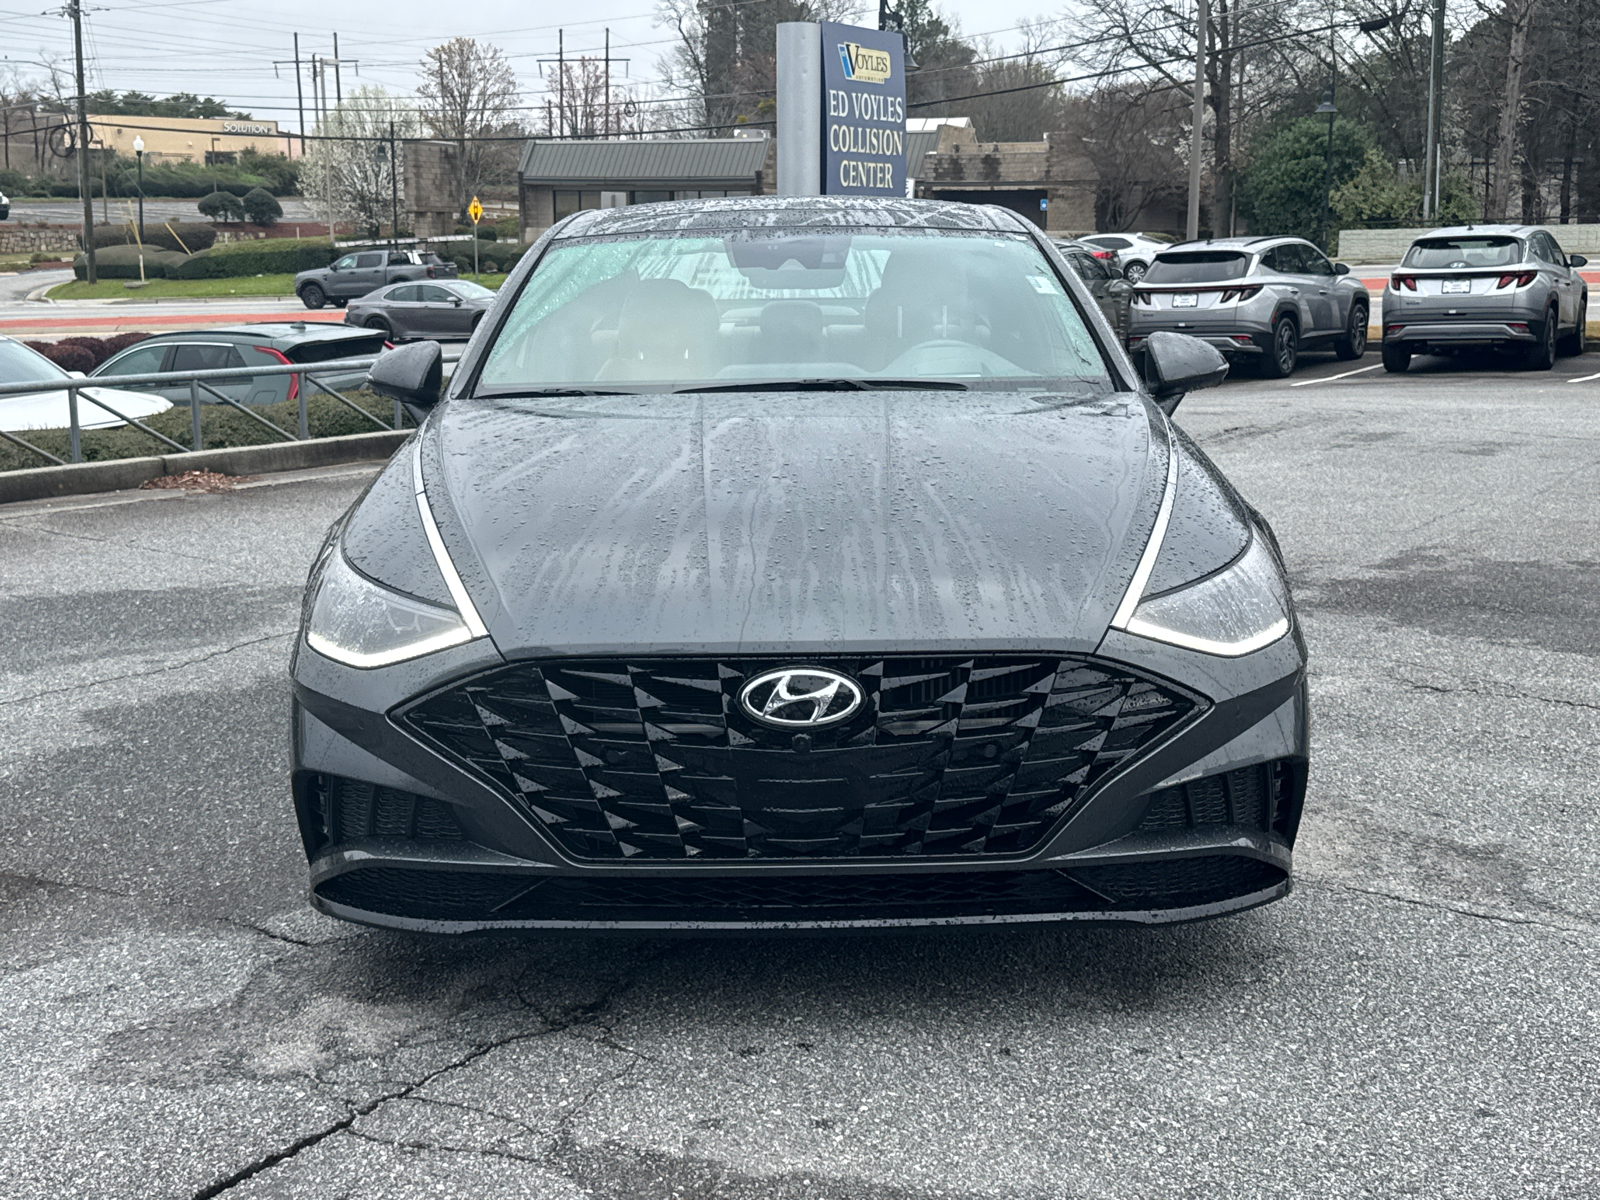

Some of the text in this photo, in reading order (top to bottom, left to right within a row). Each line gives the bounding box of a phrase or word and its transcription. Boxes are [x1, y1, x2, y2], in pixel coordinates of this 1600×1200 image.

[845, 44, 888, 76] VOYLES
[829, 89, 903, 124] ED VOYLES
[830, 124, 903, 156] COLLISION
[839, 159, 894, 189] CENTER
